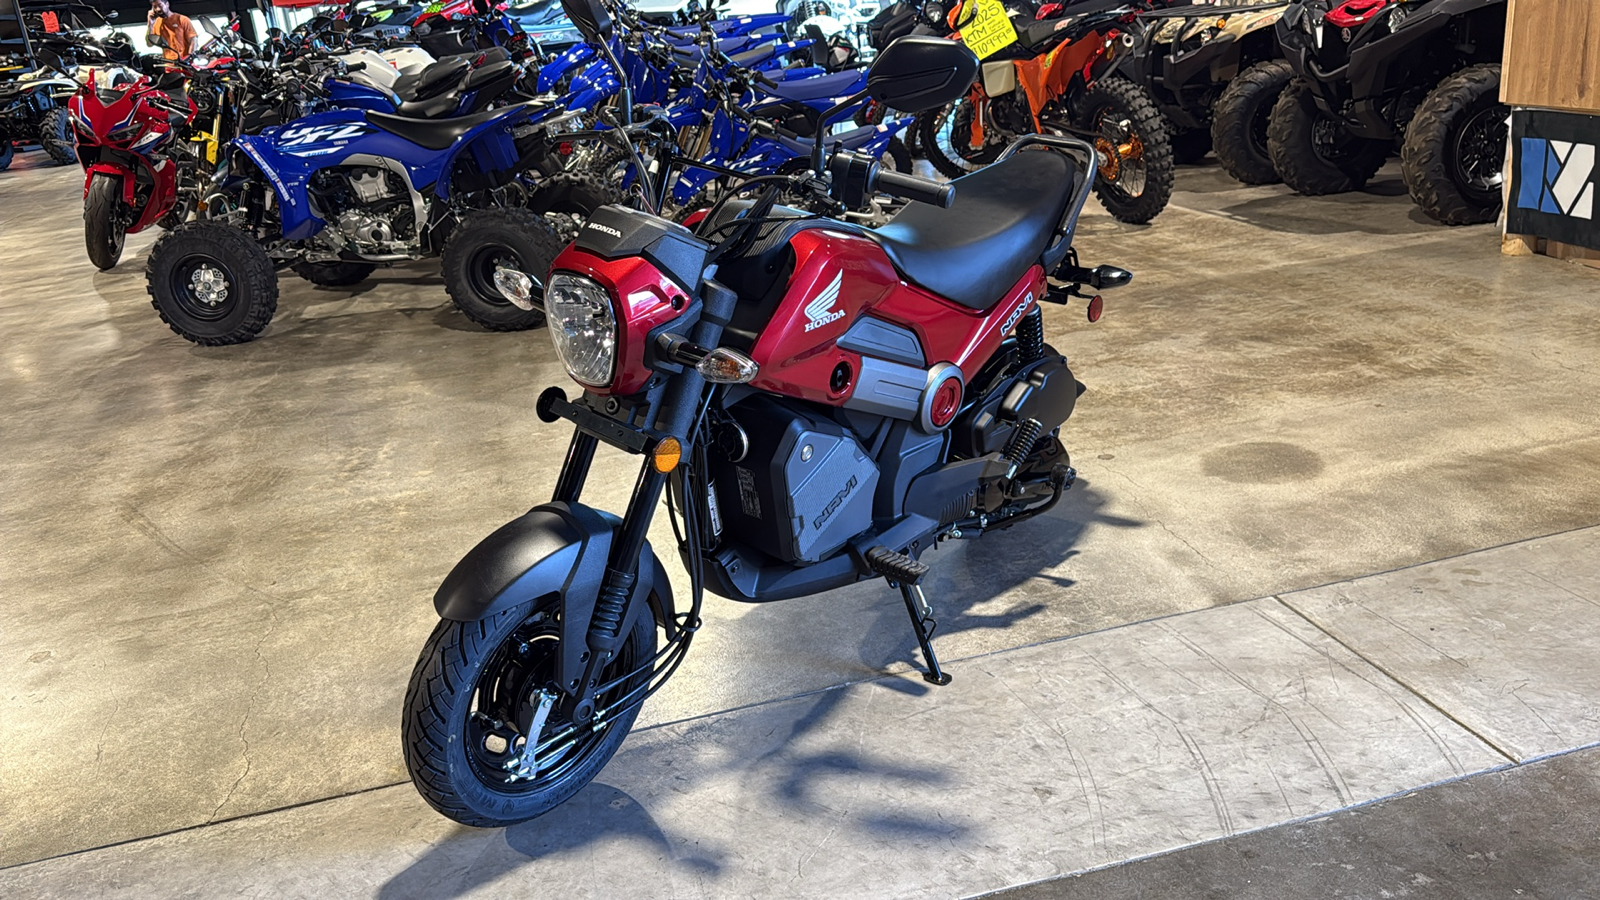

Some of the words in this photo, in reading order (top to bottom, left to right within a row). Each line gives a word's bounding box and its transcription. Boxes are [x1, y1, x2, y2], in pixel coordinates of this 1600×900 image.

[971, 3, 1000, 28] 2025
[965, 25, 987, 44] KTM
[278, 122, 367, 146] YFZ
[588, 222, 622, 238] HONDA
[804, 309, 846, 333] HONDA
[1001, 291, 1034, 337] NAVI
[813, 474, 858, 530] NAVI
